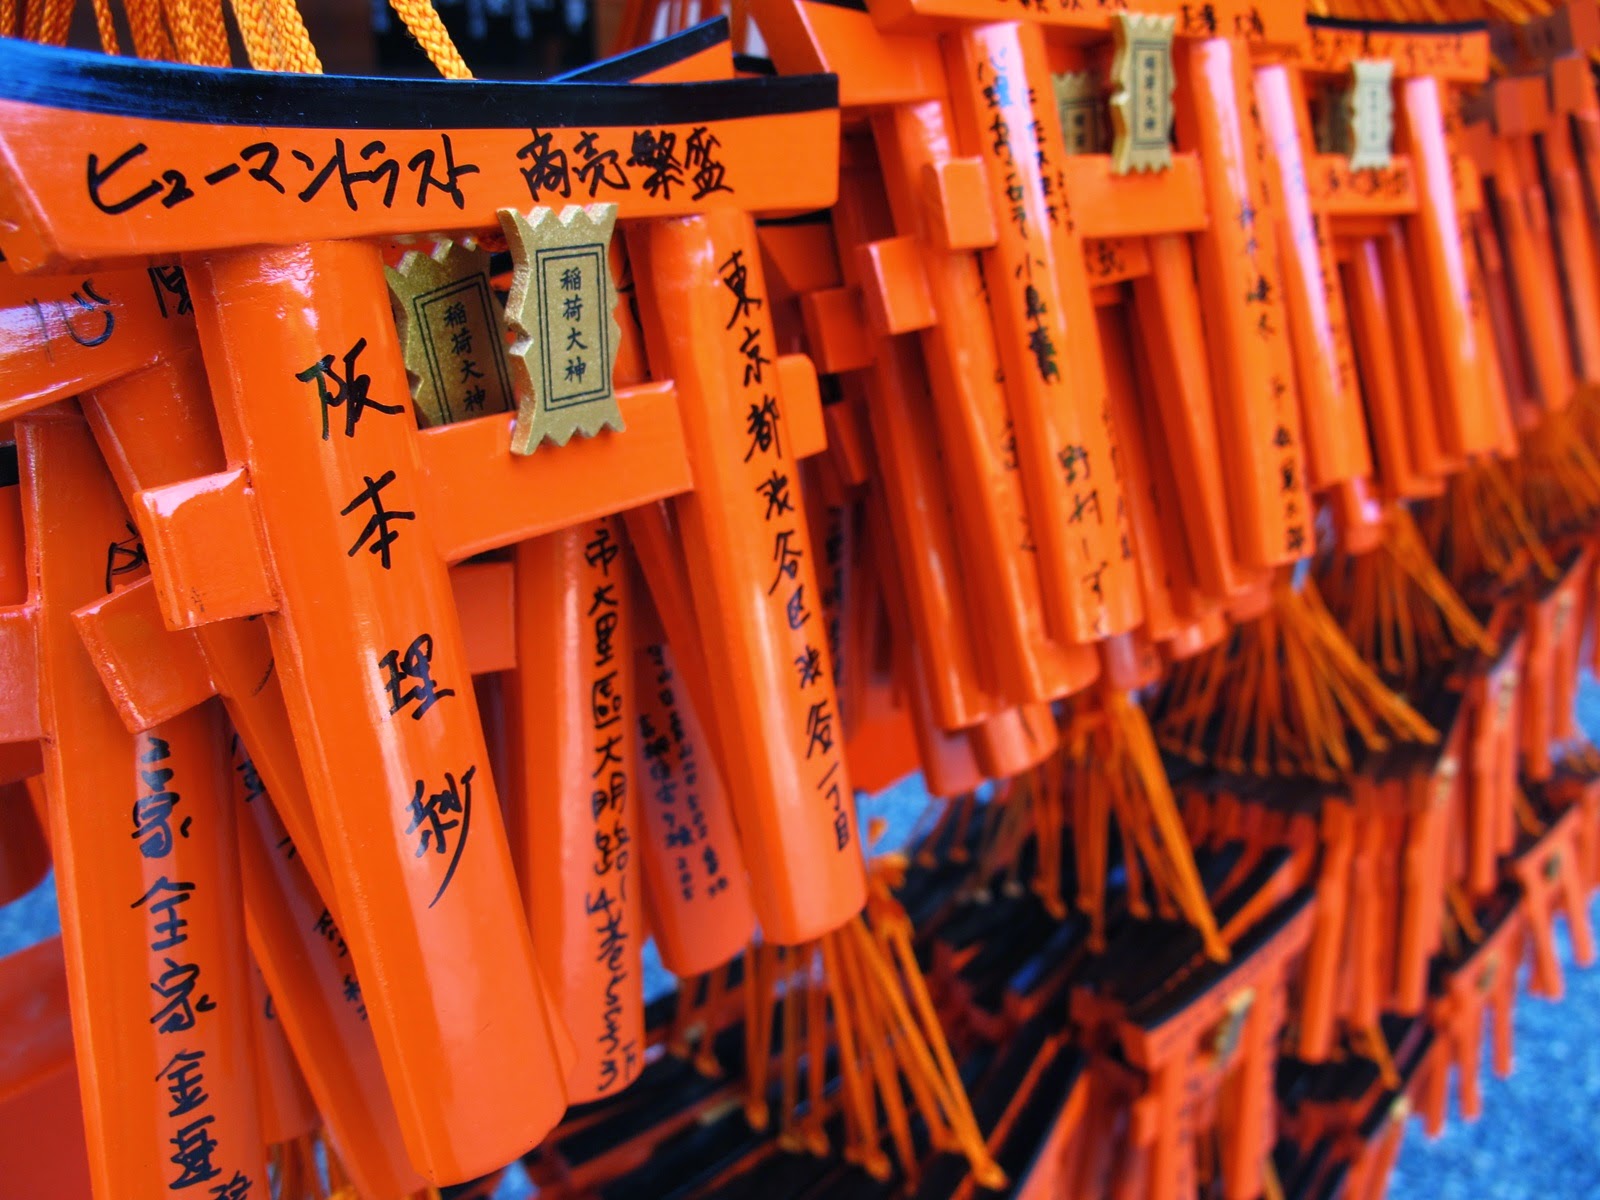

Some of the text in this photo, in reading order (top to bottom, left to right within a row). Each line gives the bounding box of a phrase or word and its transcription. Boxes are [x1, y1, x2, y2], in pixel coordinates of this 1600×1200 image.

[87, 133, 480, 215] ヒューマントラスト
[516, 127, 735, 203] 商売繁盛
[443, 302, 487, 412] 稲荷大神
[559, 266, 588, 385] 稲荷大神
